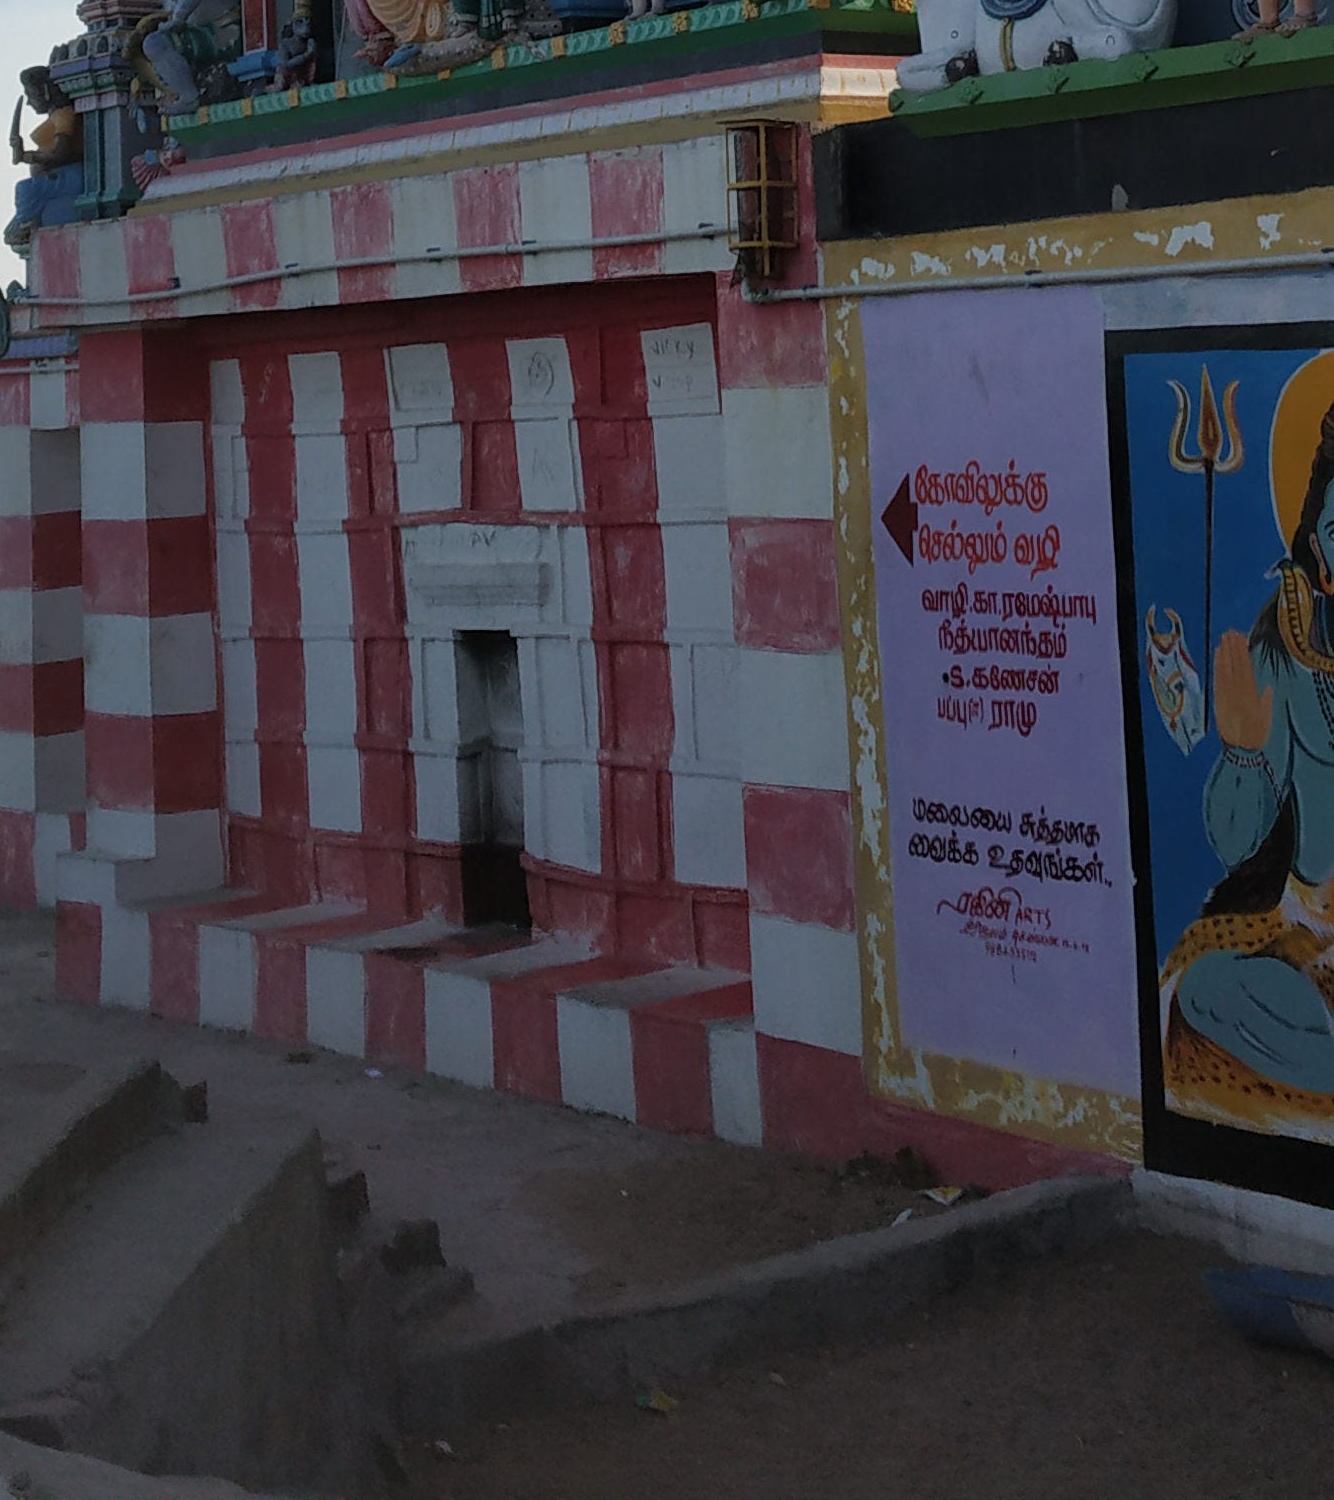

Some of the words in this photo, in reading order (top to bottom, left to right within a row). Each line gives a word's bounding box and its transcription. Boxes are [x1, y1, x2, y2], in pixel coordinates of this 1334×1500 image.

[915, 460, 1048, 516] கோவிலுக்கு
[919, 520, 1007, 575] செல்லும்
[1014, 524, 1060, 580] வழி
[988, 700, 1036, 737] ராமு
[909, 830, 979, 865] வைக்க
[913, 798, 1012, 833] மலையை
[1019, 806, 1100, 848] சுத்தமாக
